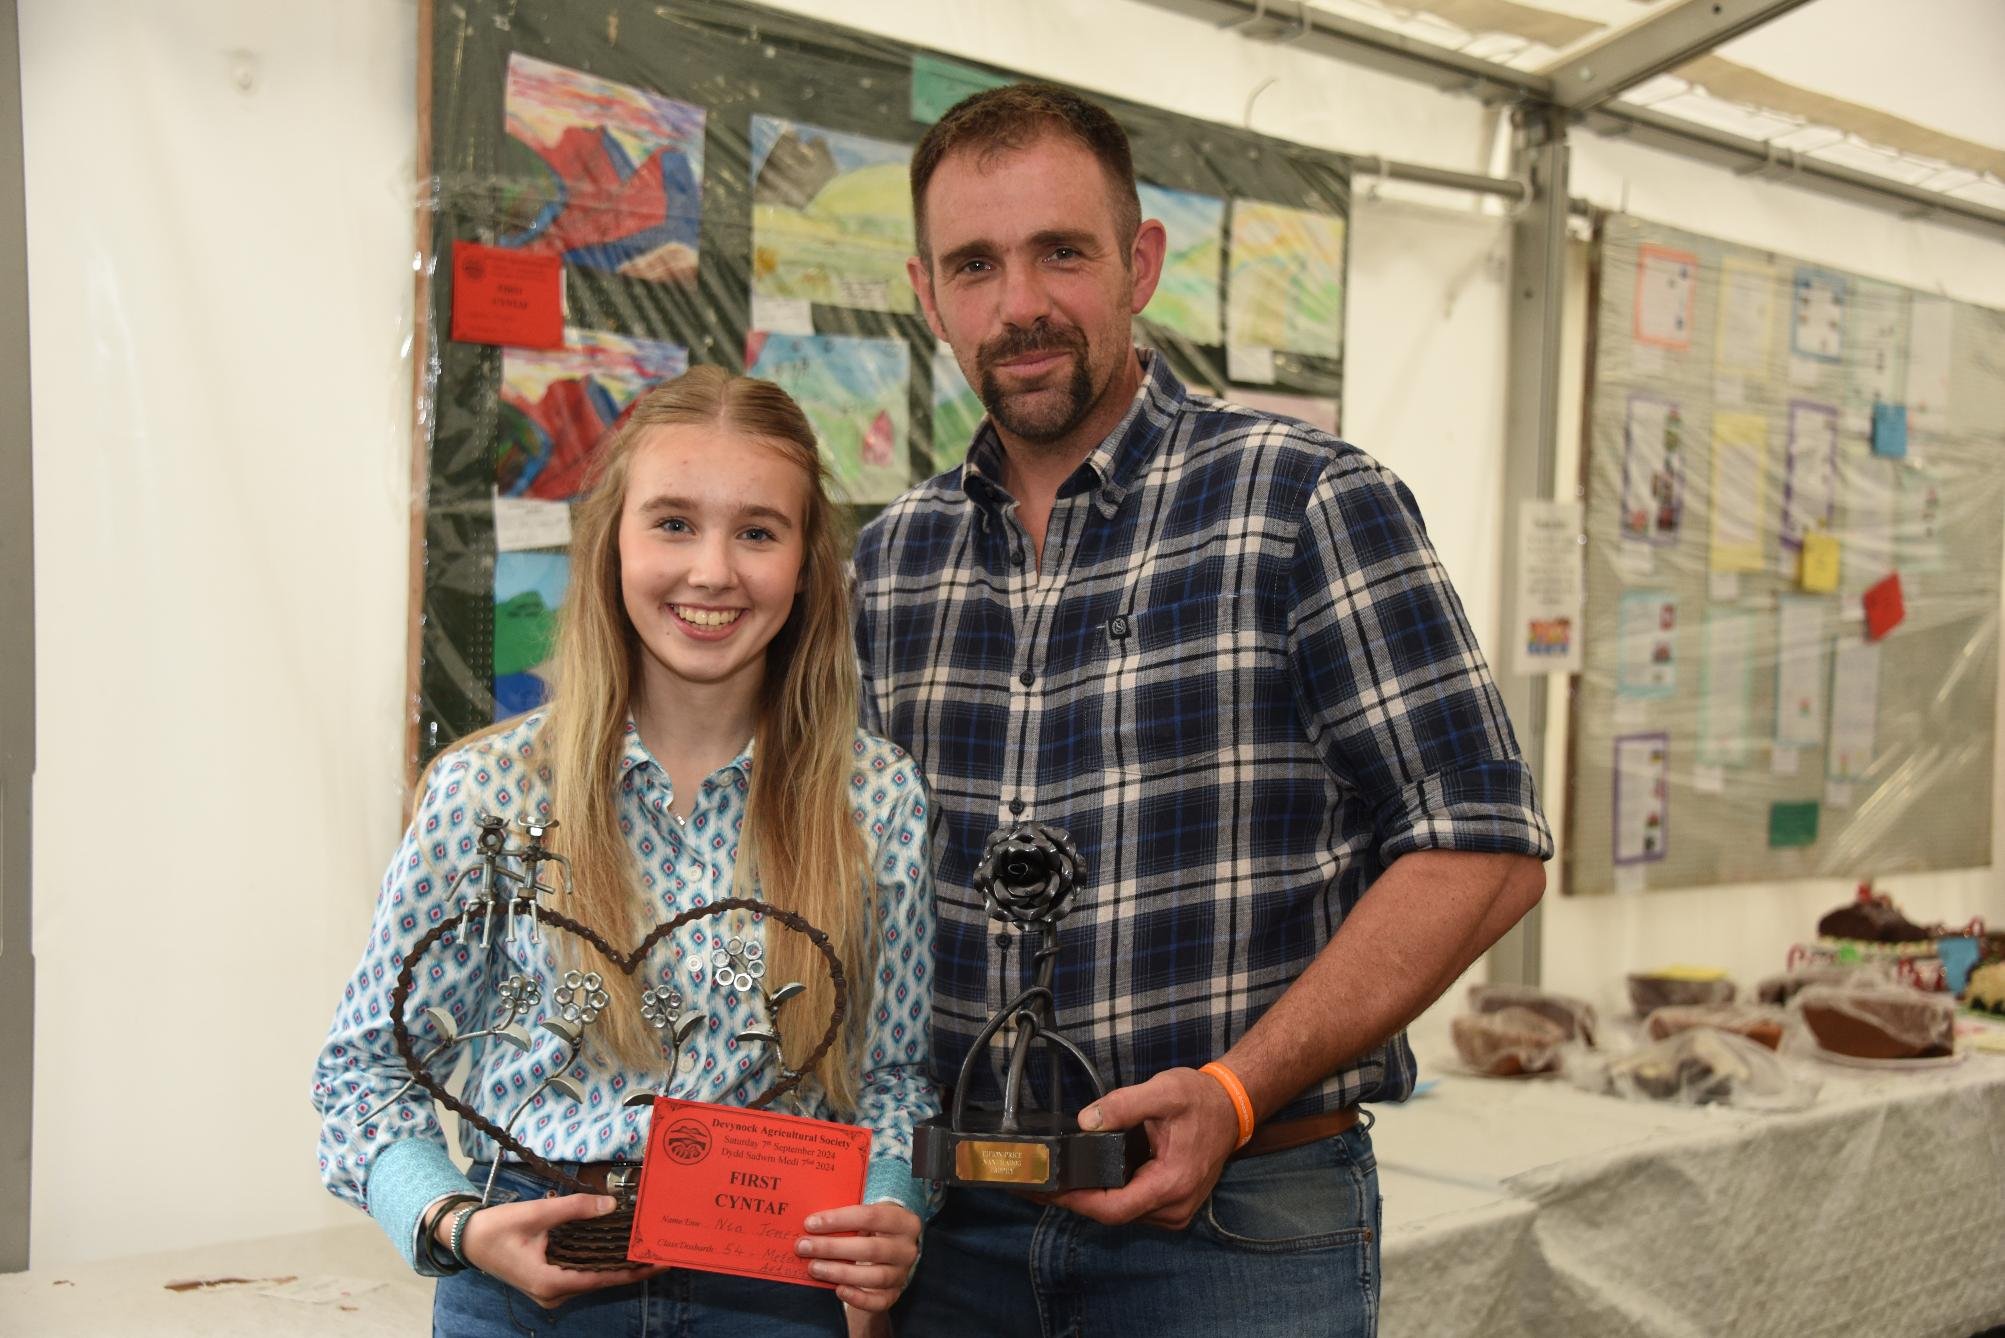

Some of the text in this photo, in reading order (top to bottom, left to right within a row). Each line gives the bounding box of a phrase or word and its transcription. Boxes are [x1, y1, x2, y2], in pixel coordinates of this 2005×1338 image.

[724, 1135, 758, 1149] Saturday
[774, 1143, 815, 1156] September
[816, 1149, 836, 1160] 2024
[761, 1125, 817, 1142] Agricultural
[819, 1134, 851, 1150] Society
[816, 1161, 835, 1172] 2024
[730, 1171, 782, 1190] FIRST
[715, 1193, 789, 1216] CYNTAF
